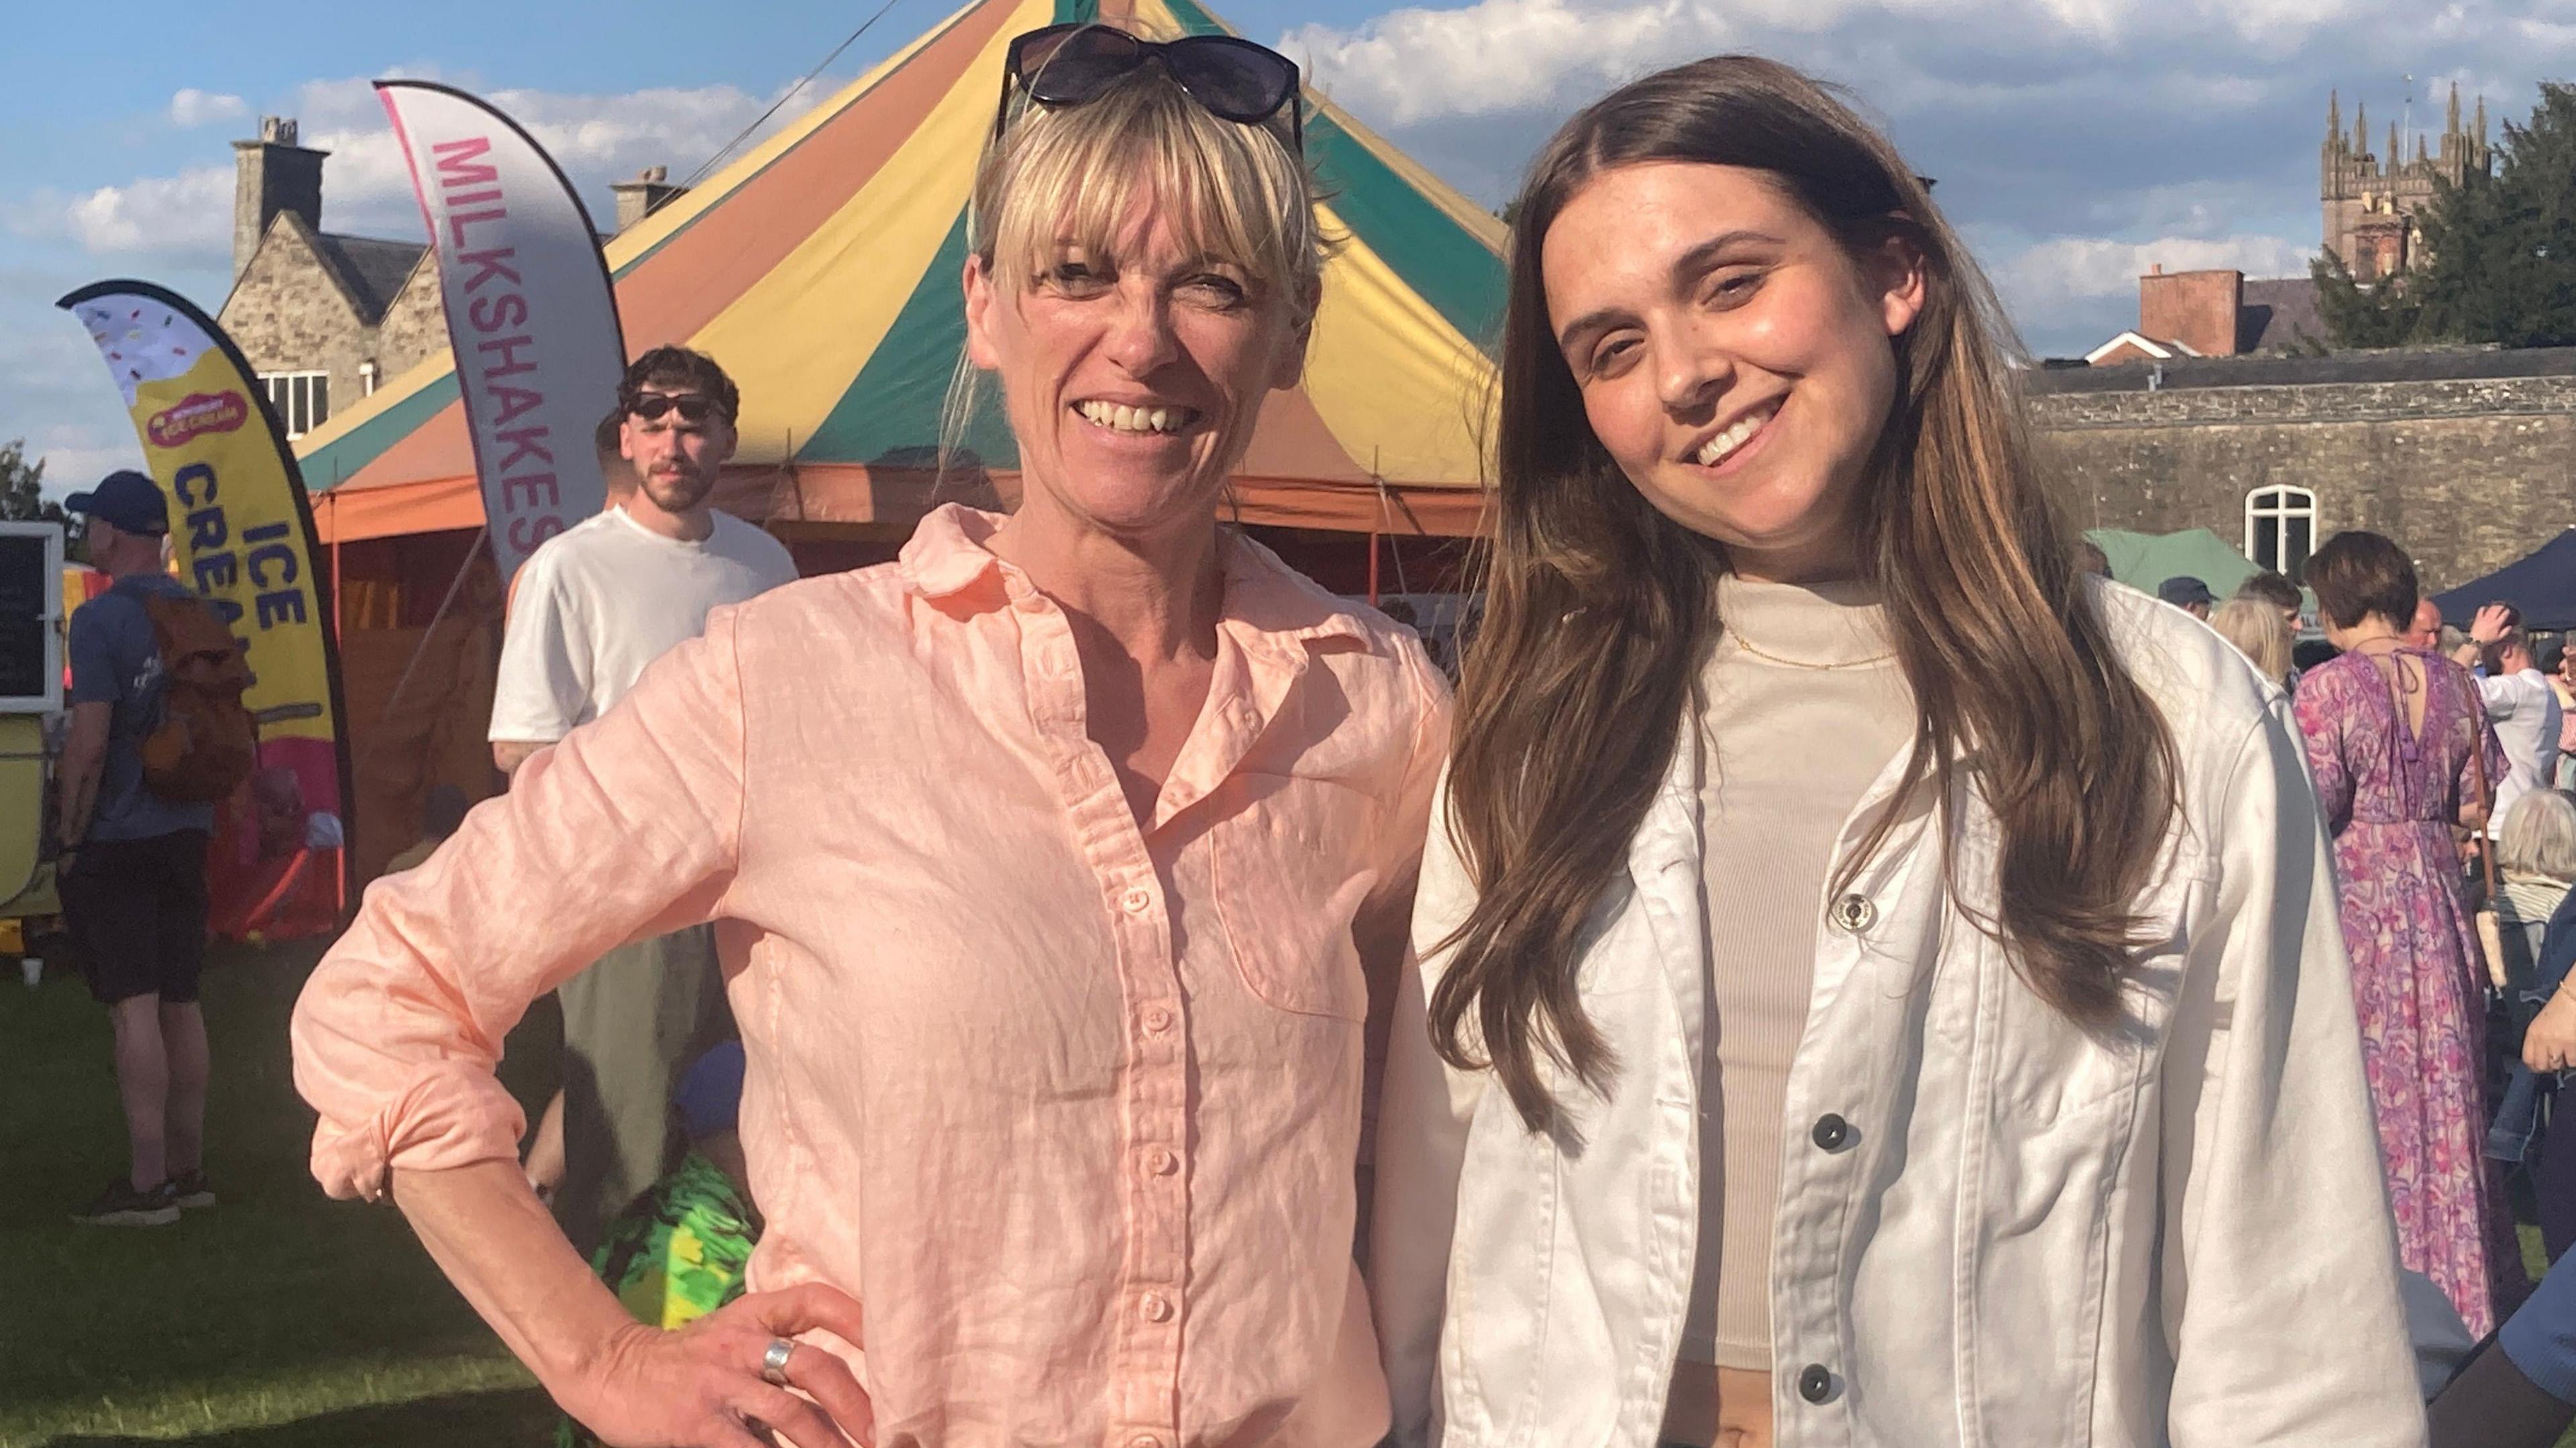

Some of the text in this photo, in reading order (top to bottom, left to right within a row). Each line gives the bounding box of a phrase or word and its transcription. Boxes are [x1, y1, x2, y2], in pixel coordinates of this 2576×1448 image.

[433, 136, 564, 555] MILKSHAKES
[173, 463, 258, 686] CREA
[242, 522, 307, 630] ICE
